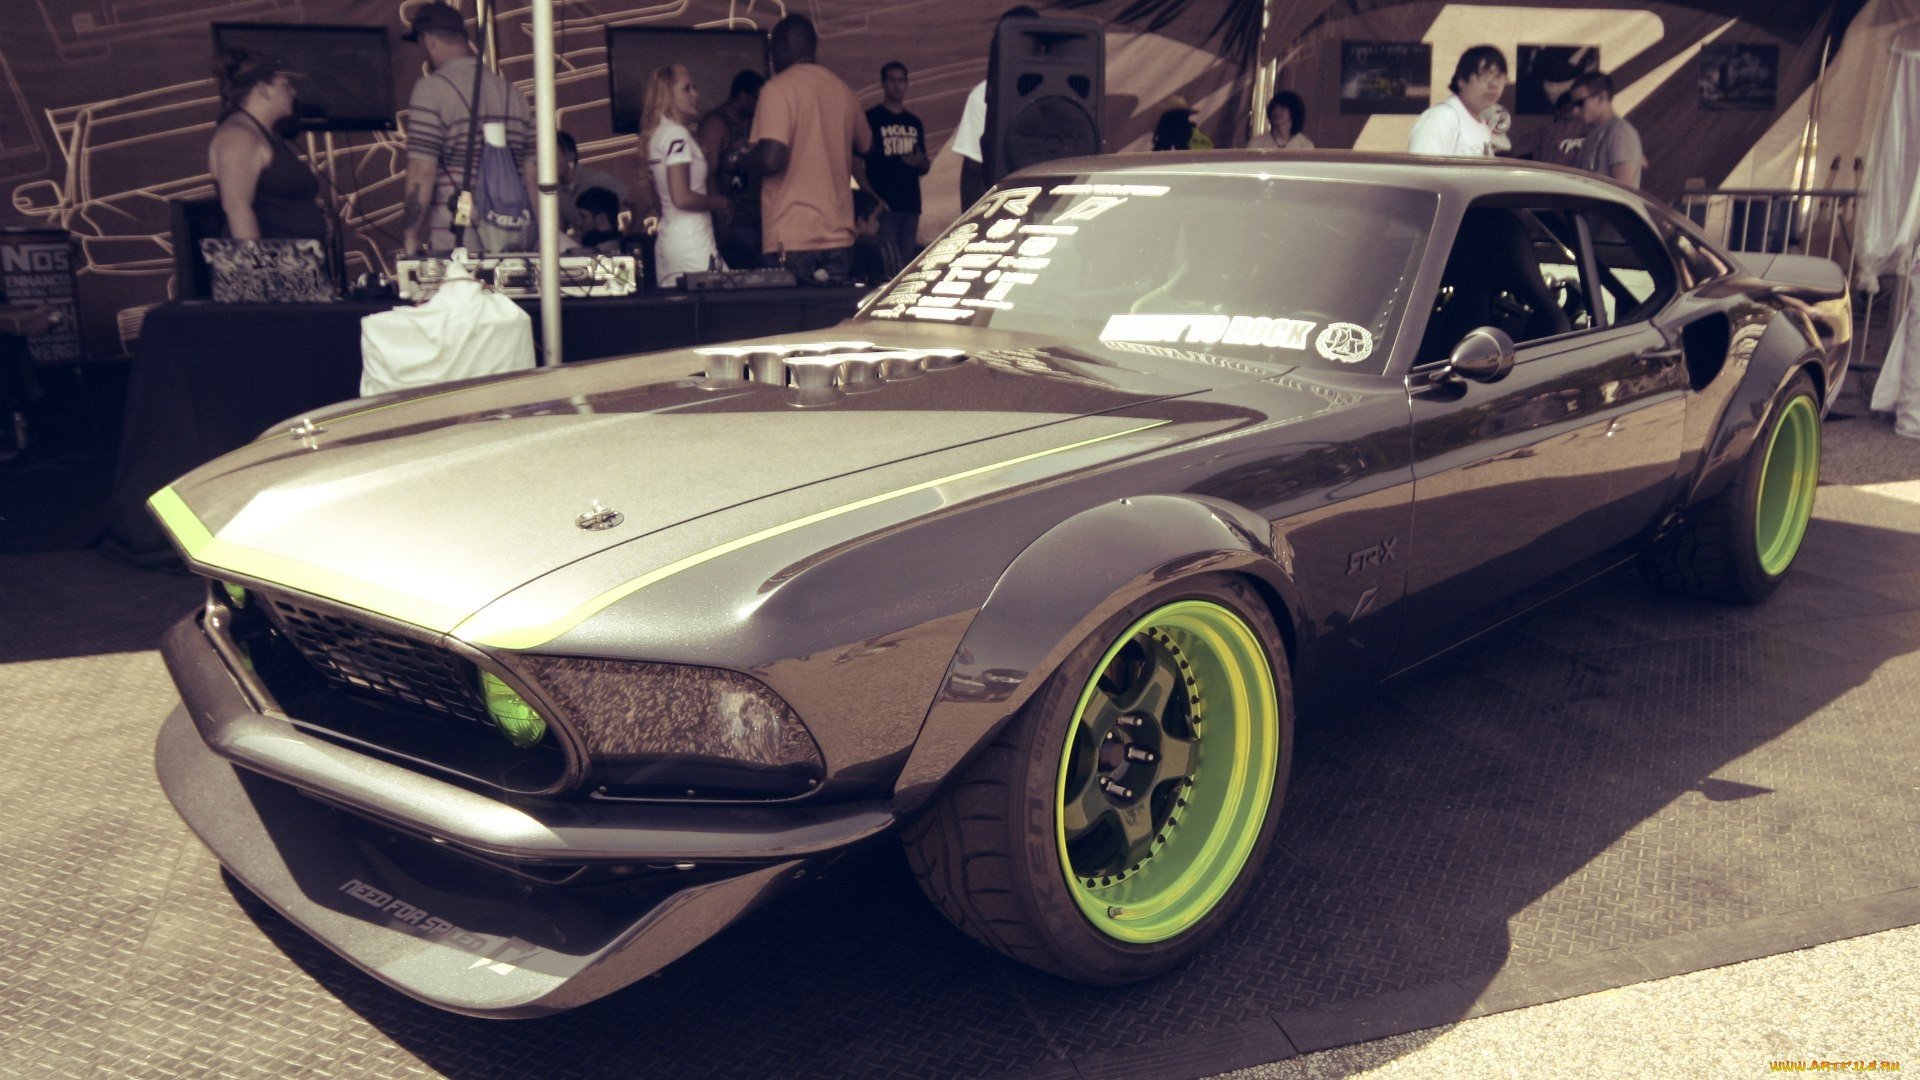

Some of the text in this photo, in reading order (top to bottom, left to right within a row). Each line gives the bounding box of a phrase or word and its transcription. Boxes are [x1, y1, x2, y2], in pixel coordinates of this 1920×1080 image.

[881, 125, 918, 137] HOLD
[1, 243, 71, 272] NOS
[338, 878, 488, 950] NEED FOR SPEED
